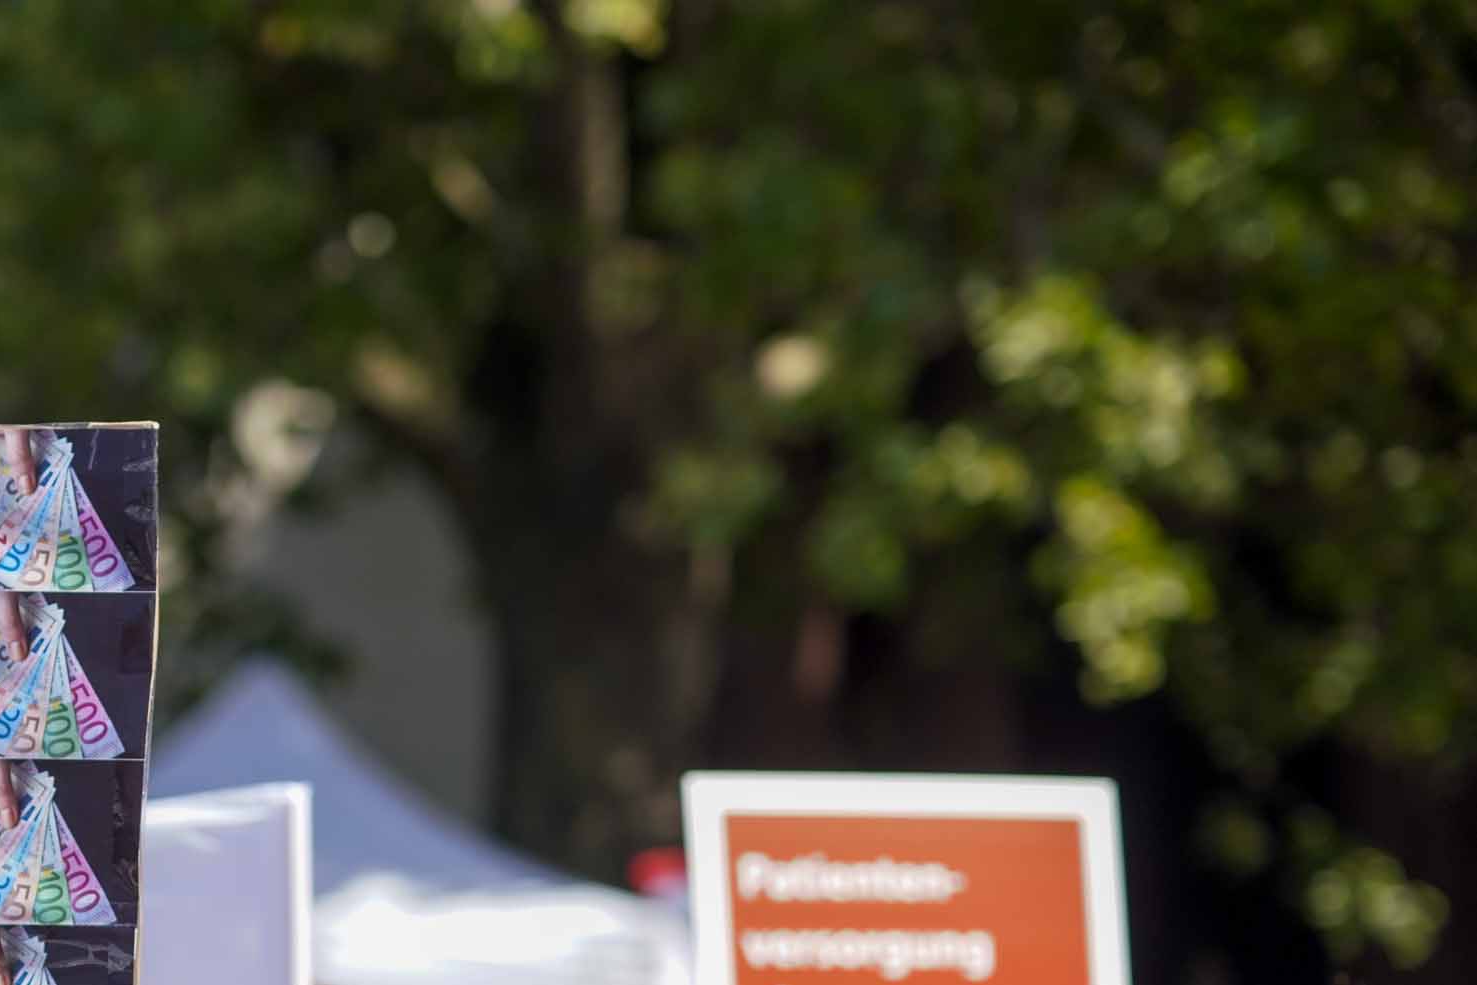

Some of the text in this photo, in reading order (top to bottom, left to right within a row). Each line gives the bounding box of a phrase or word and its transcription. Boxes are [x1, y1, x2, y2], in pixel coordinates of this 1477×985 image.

[20, 550, 50, 586] 50
[54, 536, 86, 590] 100
[79, 515, 118, 577] 500
[12, 717, 39, 753] 50
[44, 703, 74, 757] 100
[71, 682, 107, 744] 500
[1, 885, 30, 921] 50
[34, 872, 67, 923] 100
[62, 850, 100, 912] 500
